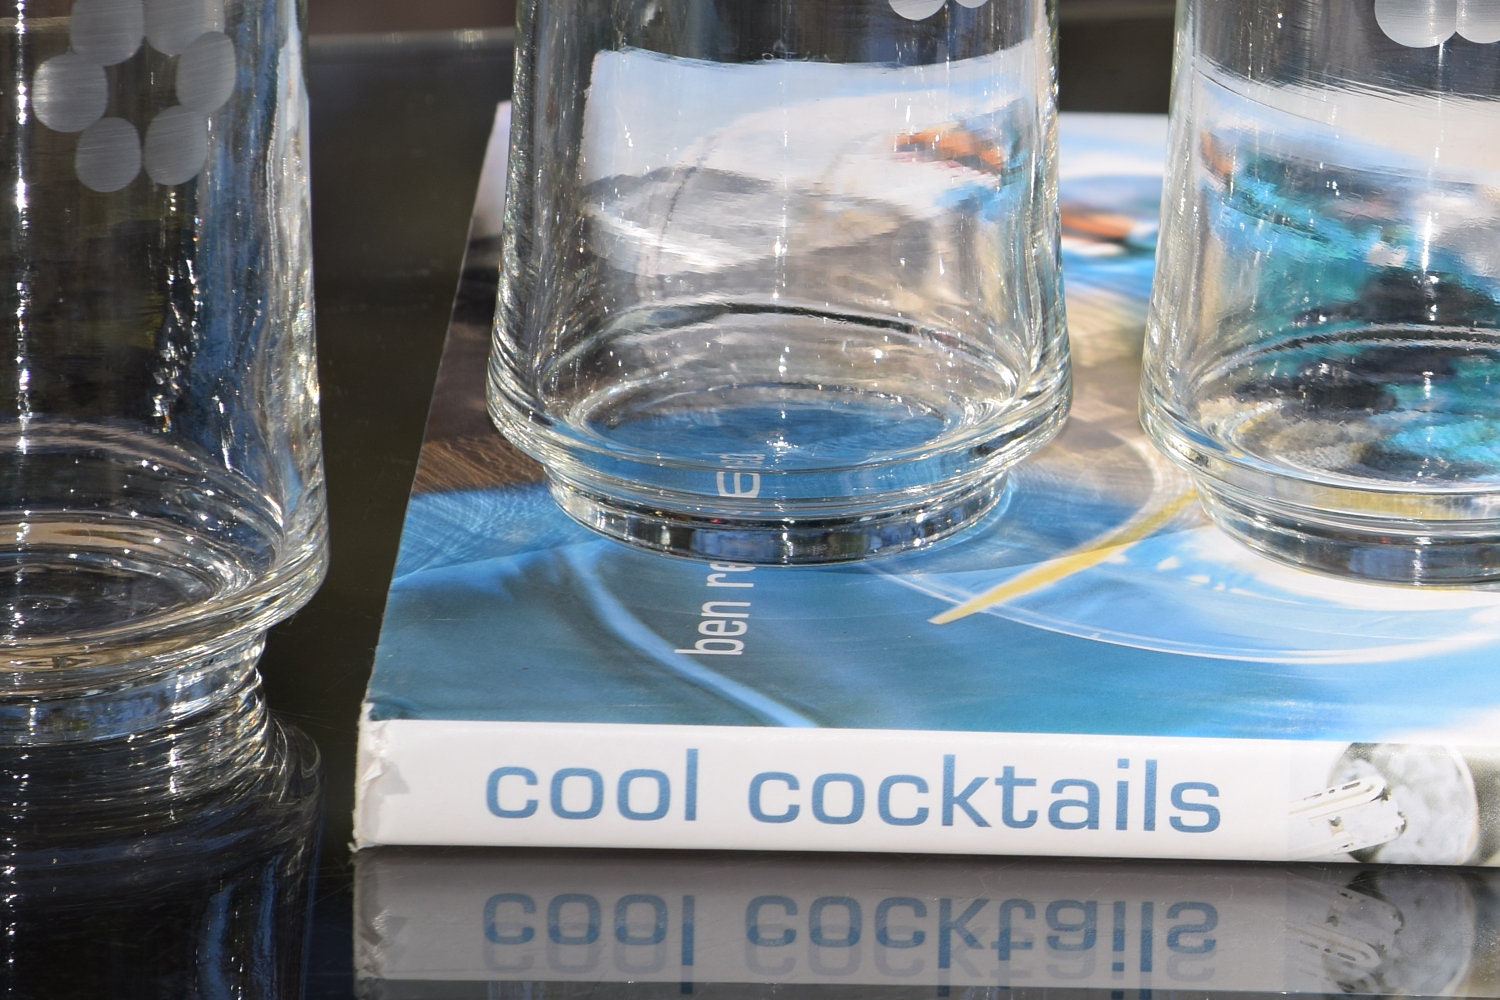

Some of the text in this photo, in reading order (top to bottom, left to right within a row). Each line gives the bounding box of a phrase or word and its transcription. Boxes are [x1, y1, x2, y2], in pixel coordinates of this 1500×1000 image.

[673, 600, 752, 656] ben
[484, 747, 1222, 835] cool cocktails
